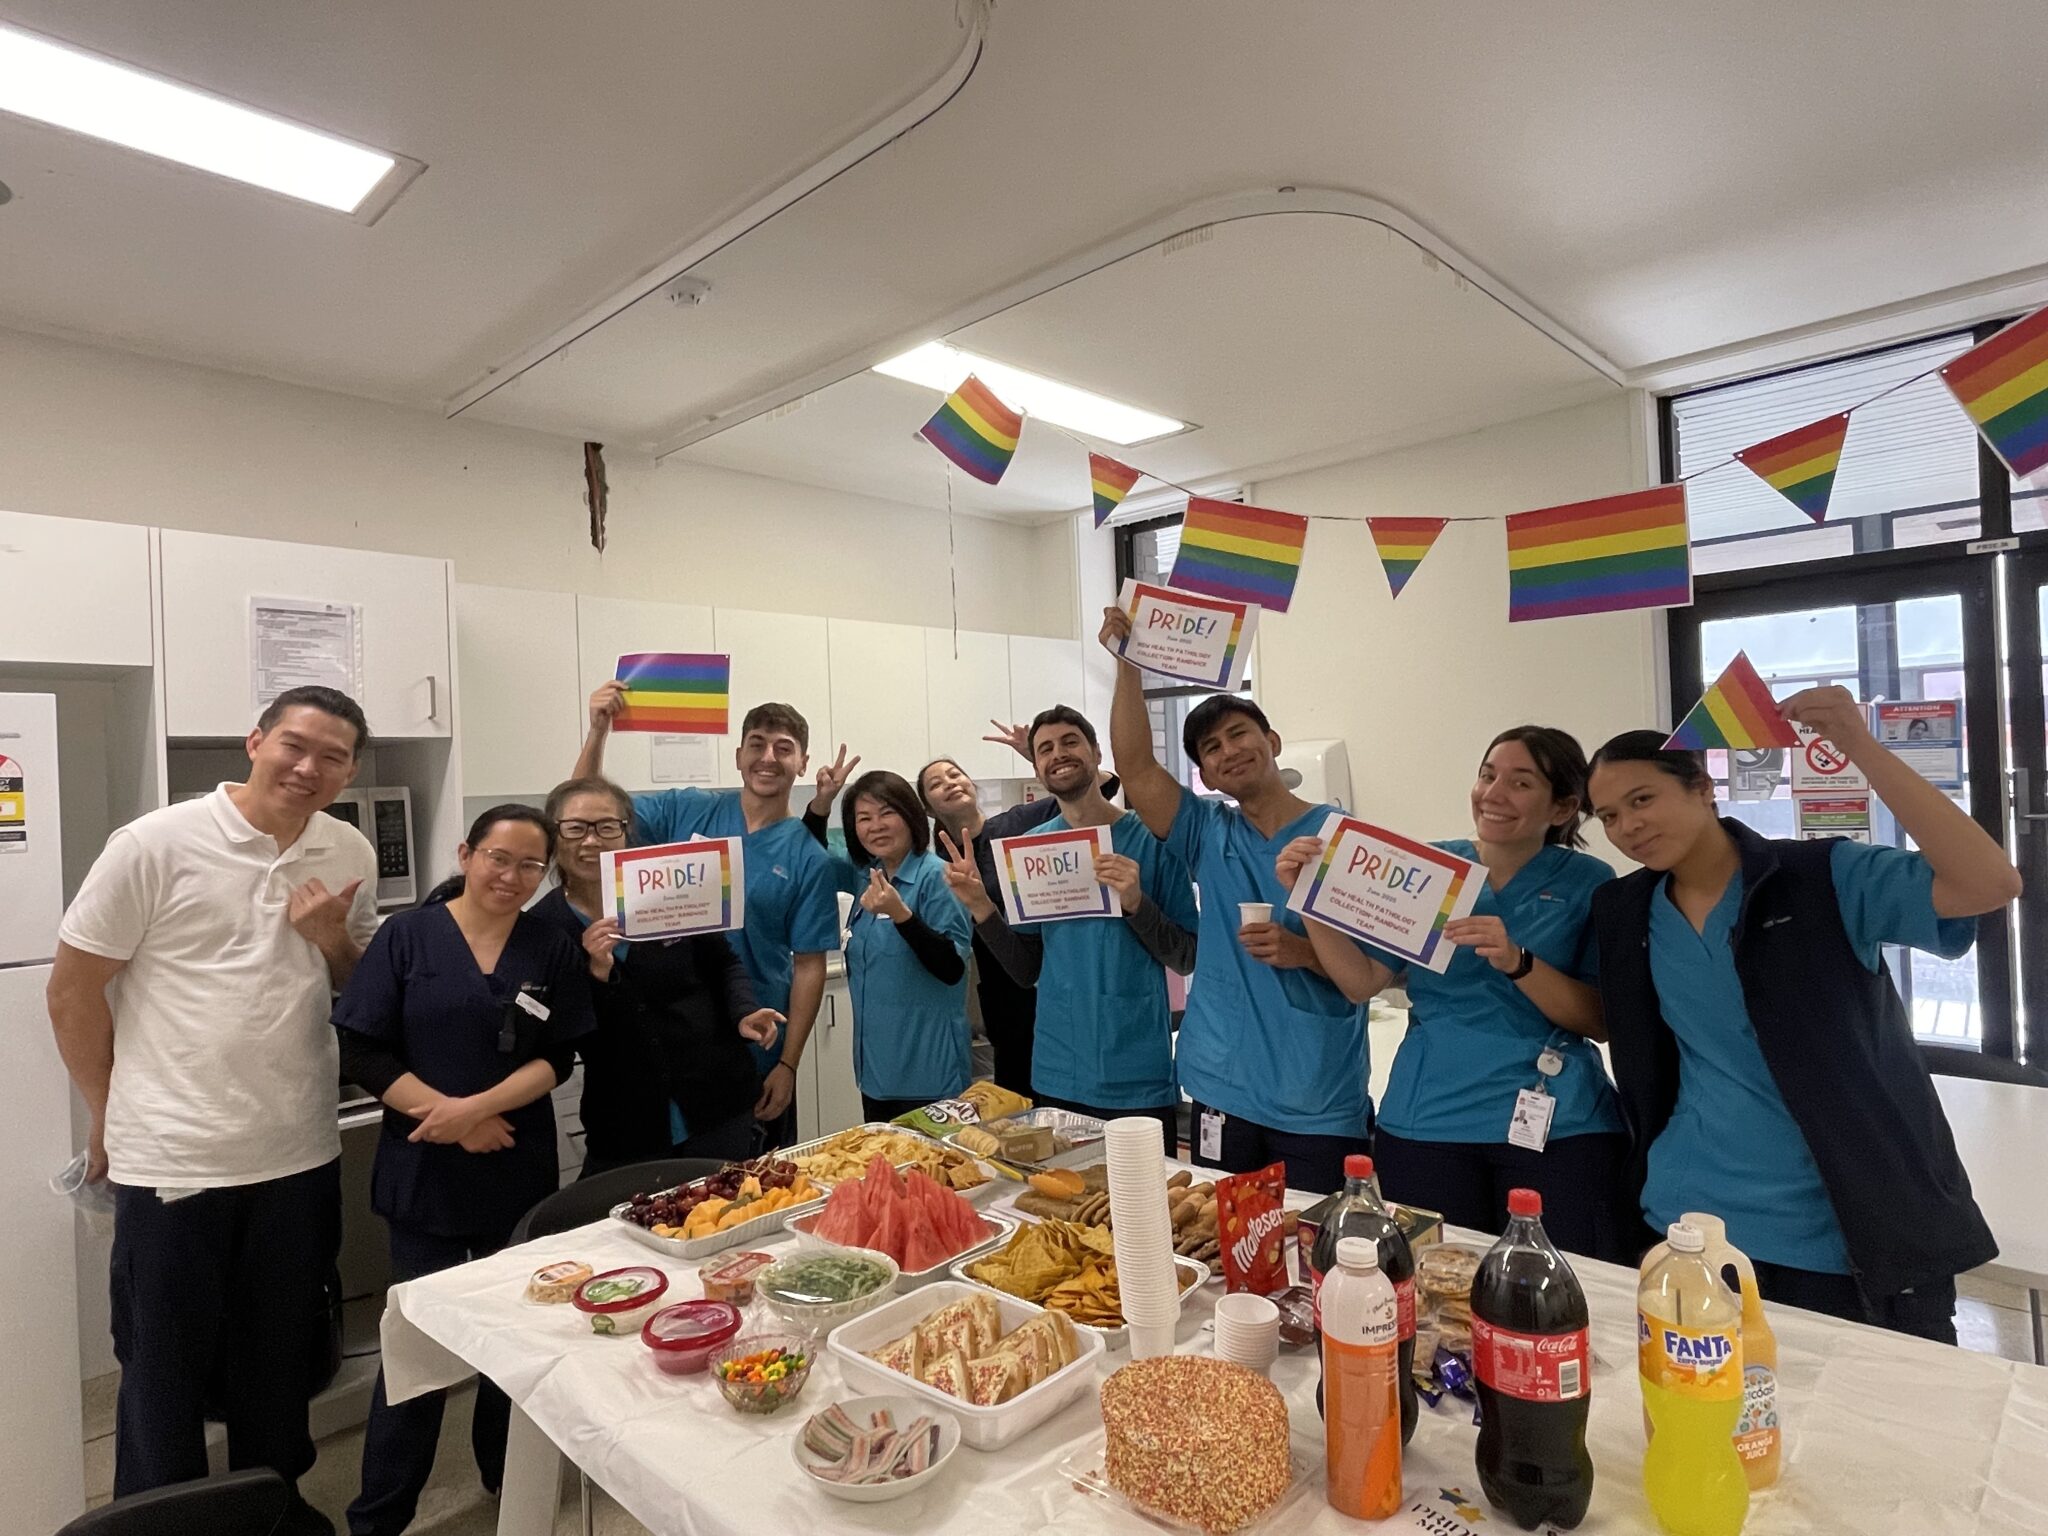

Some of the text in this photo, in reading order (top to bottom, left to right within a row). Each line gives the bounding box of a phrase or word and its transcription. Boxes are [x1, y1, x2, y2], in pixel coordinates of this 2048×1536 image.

[1148, 608, 1217, 639] PRIDE!
[638, 863, 705, 894] PRIDE!
[1024, 851, 1079, 880] PRIDE!
[1347, 845, 1432, 900] PRIDE!
[1331, 886, 1416, 927] NSW HEALTH PATHOLOGY
[1356, 918, 1375, 932] TEAM
[1374, 915, 1410, 935] RANDWICK
[1736, 1435, 1773, 1452] ORANGE
